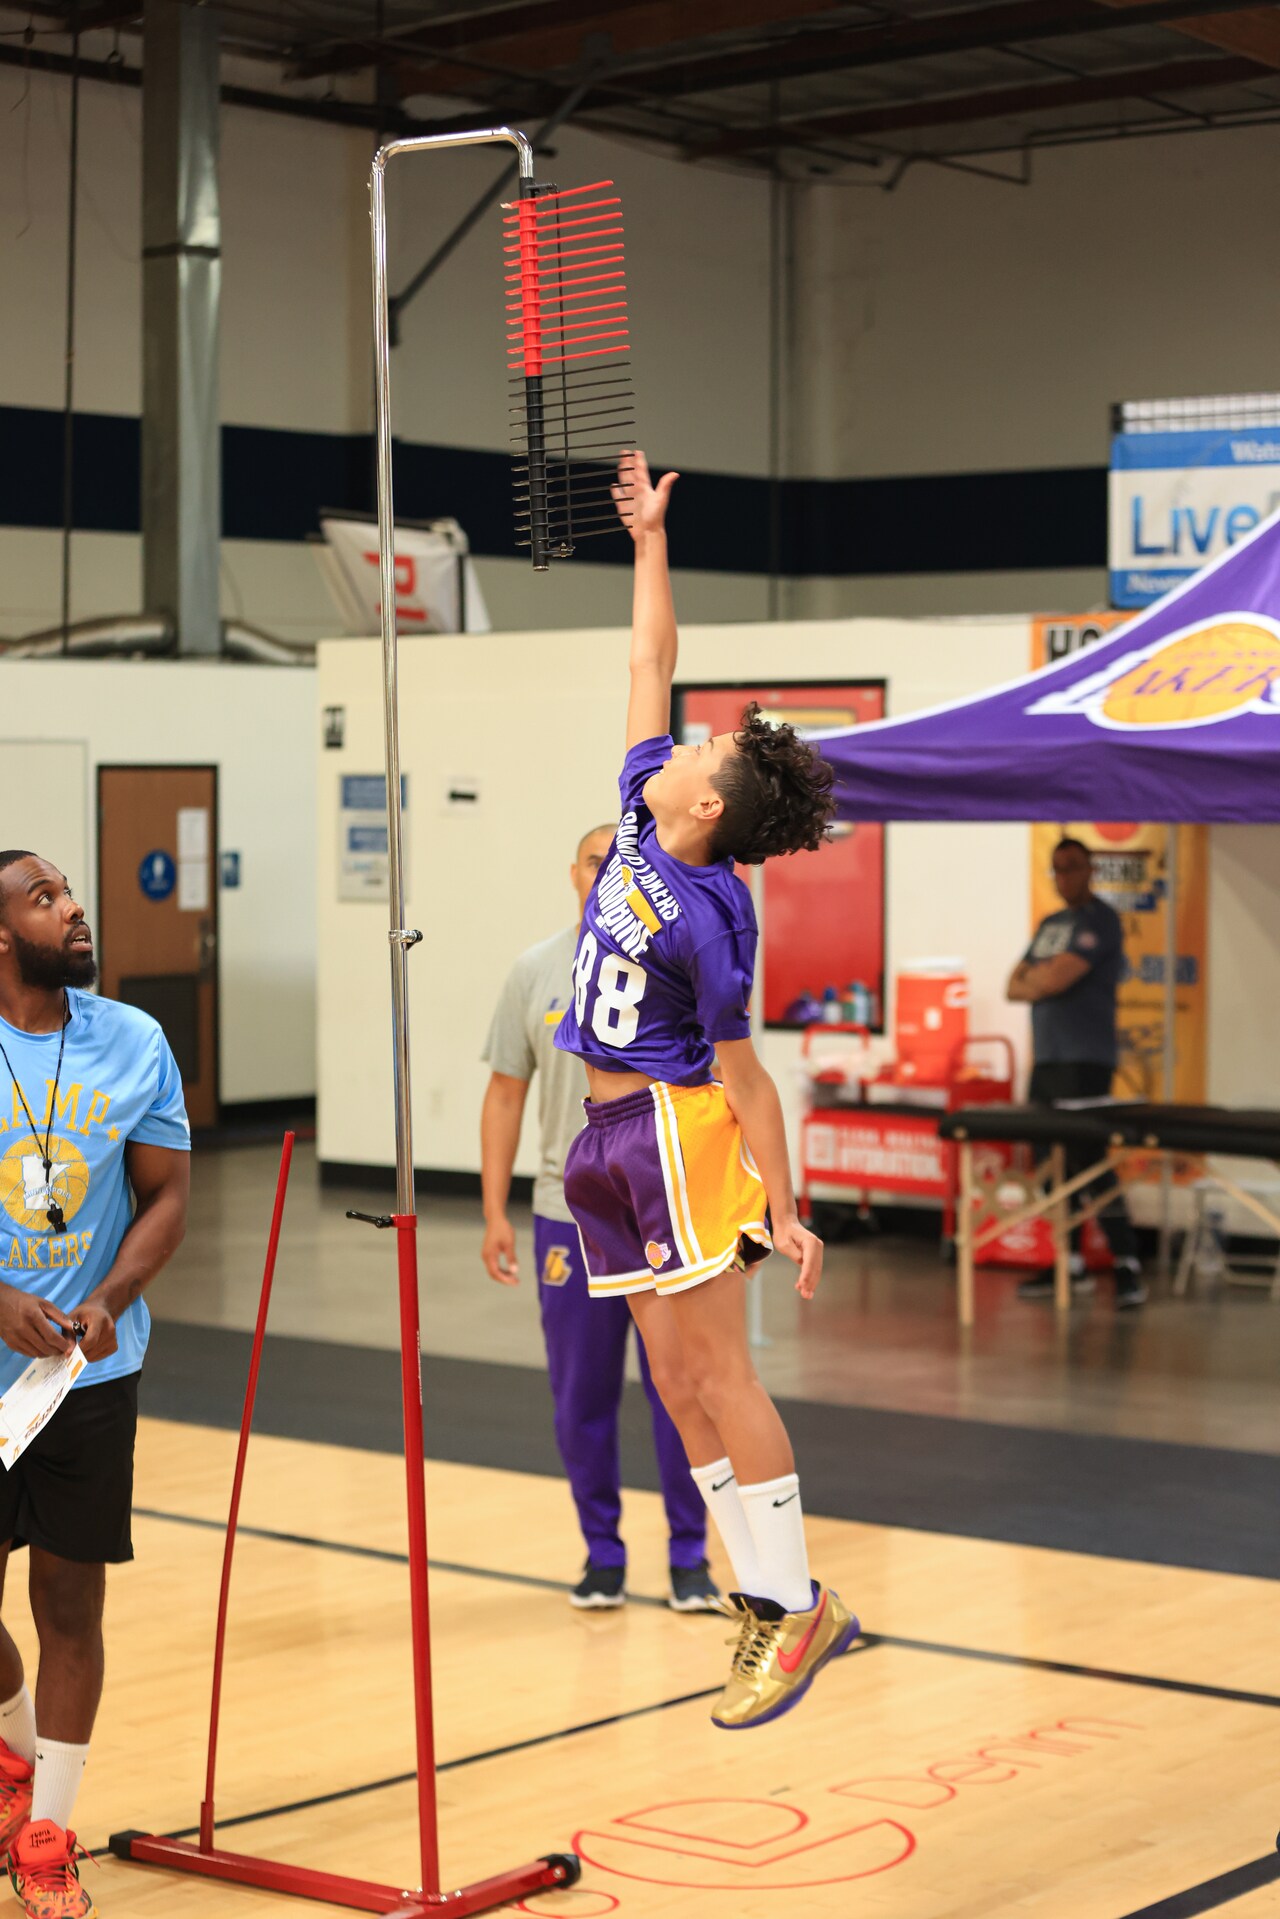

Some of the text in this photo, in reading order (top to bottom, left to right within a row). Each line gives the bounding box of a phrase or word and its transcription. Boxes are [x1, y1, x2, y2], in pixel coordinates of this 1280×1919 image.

[1131, 495, 1280, 557] Live
[616, 811, 682, 921] CAMP LAKERS
[597, 853, 654, 964] COMBINE
[0, 1078, 111, 1137] AMP
[0, 1231, 94, 1269] AKERS
[826, 1716, 1148, 1811] Denim
